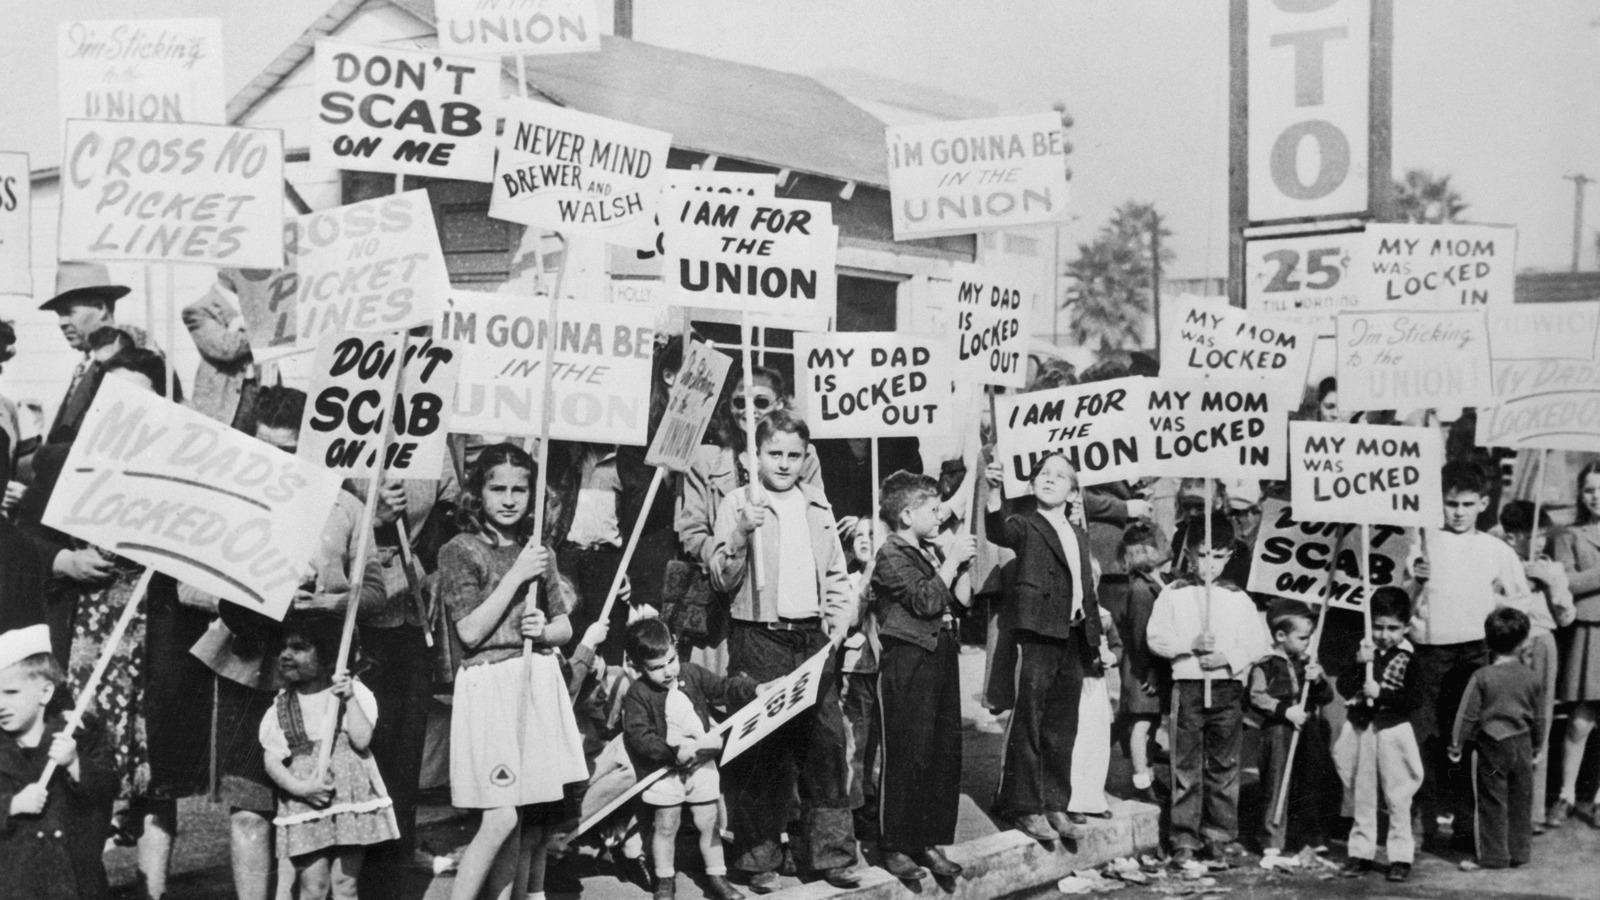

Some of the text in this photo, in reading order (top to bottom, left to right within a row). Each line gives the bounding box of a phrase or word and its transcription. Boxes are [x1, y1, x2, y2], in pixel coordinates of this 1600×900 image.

[449, 11, 587, 44] UNION
[333, 53, 475, 95] DON'T
[319, 91, 482, 137] SCAB
[1269, 0, 1351, 200] TO
[69, 130, 268, 190] CROSS NO
[333, 134, 456, 166] ON ME
[513, 120, 652, 179] NEVER MIND
[930, 133, 1026, 165] GONNA
[1032, 129, 1064, 157] BE
[502, 164, 612, 198] BREWER AND
[937, 167, 1023, 188] IN THE
[95, 178, 256, 223] PICKET
[558, 192, 643, 223] WALSH
[904, 186, 1053, 223] UNION
[680, 200, 811, 236] I AM FOR
[87, 222, 249, 258] LINES
[347, 237, 380, 261] NO
[721, 236, 775, 256] THE
[1378, 238, 1419, 256] MY
[267, 251, 430, 313] PICKET
[680, 258, 817, 299] UNION
[1372, 262, 1412, 274] WAS
[1386, 261, 1491, 300] LOCKED
[958, 281, 1021, 310] MY DAD
[1460, 288, 1488, 305] IN
[267, 286, 415, 347] LINES
[958, 311, 972, 331] IS
[1186, 307, 1224, 329] MY
[485, 313, 604, 355] GONNA
[612, 324, 654, 359] BE
[959, 318, 1020, 361] LOCKED
[1181, 329, 1215, 348] WAS
[1386, 315, 1475, 350] Sticking
[500, 357, 611, 384] IN THE
[807, 346, 931, 369] MY DAD
[990, 348, 1020, 374] OUT
[1188, 346, 1287, 371] LOCKED
[1373, 348, 1403, 366] the
[814, 374, 837, 393] IS
[821, 371, 927, 421] LOCKED
[882, 404, 938, 425] OUT
[1009, 388, 1127, 430] I AM FOR
[1148, 390, 1268, 413] MY MOM
[84, 401, 169, 463] MY
[1048, 422, 1093, 442] THE
[1155, 417, 1265, 460] LOCKED
[1305, 436, 1420, 458] MY MOM
[325, 438, 367, 468] ON
[1239, 445, 1269, 466] IN
[1303, 459, 1344, 473] WAS
[1314, 465, 1420, 502] LOCKED
[1392, 493, 1419, 512] IN
[1276, 572, 1317, 594] ON
